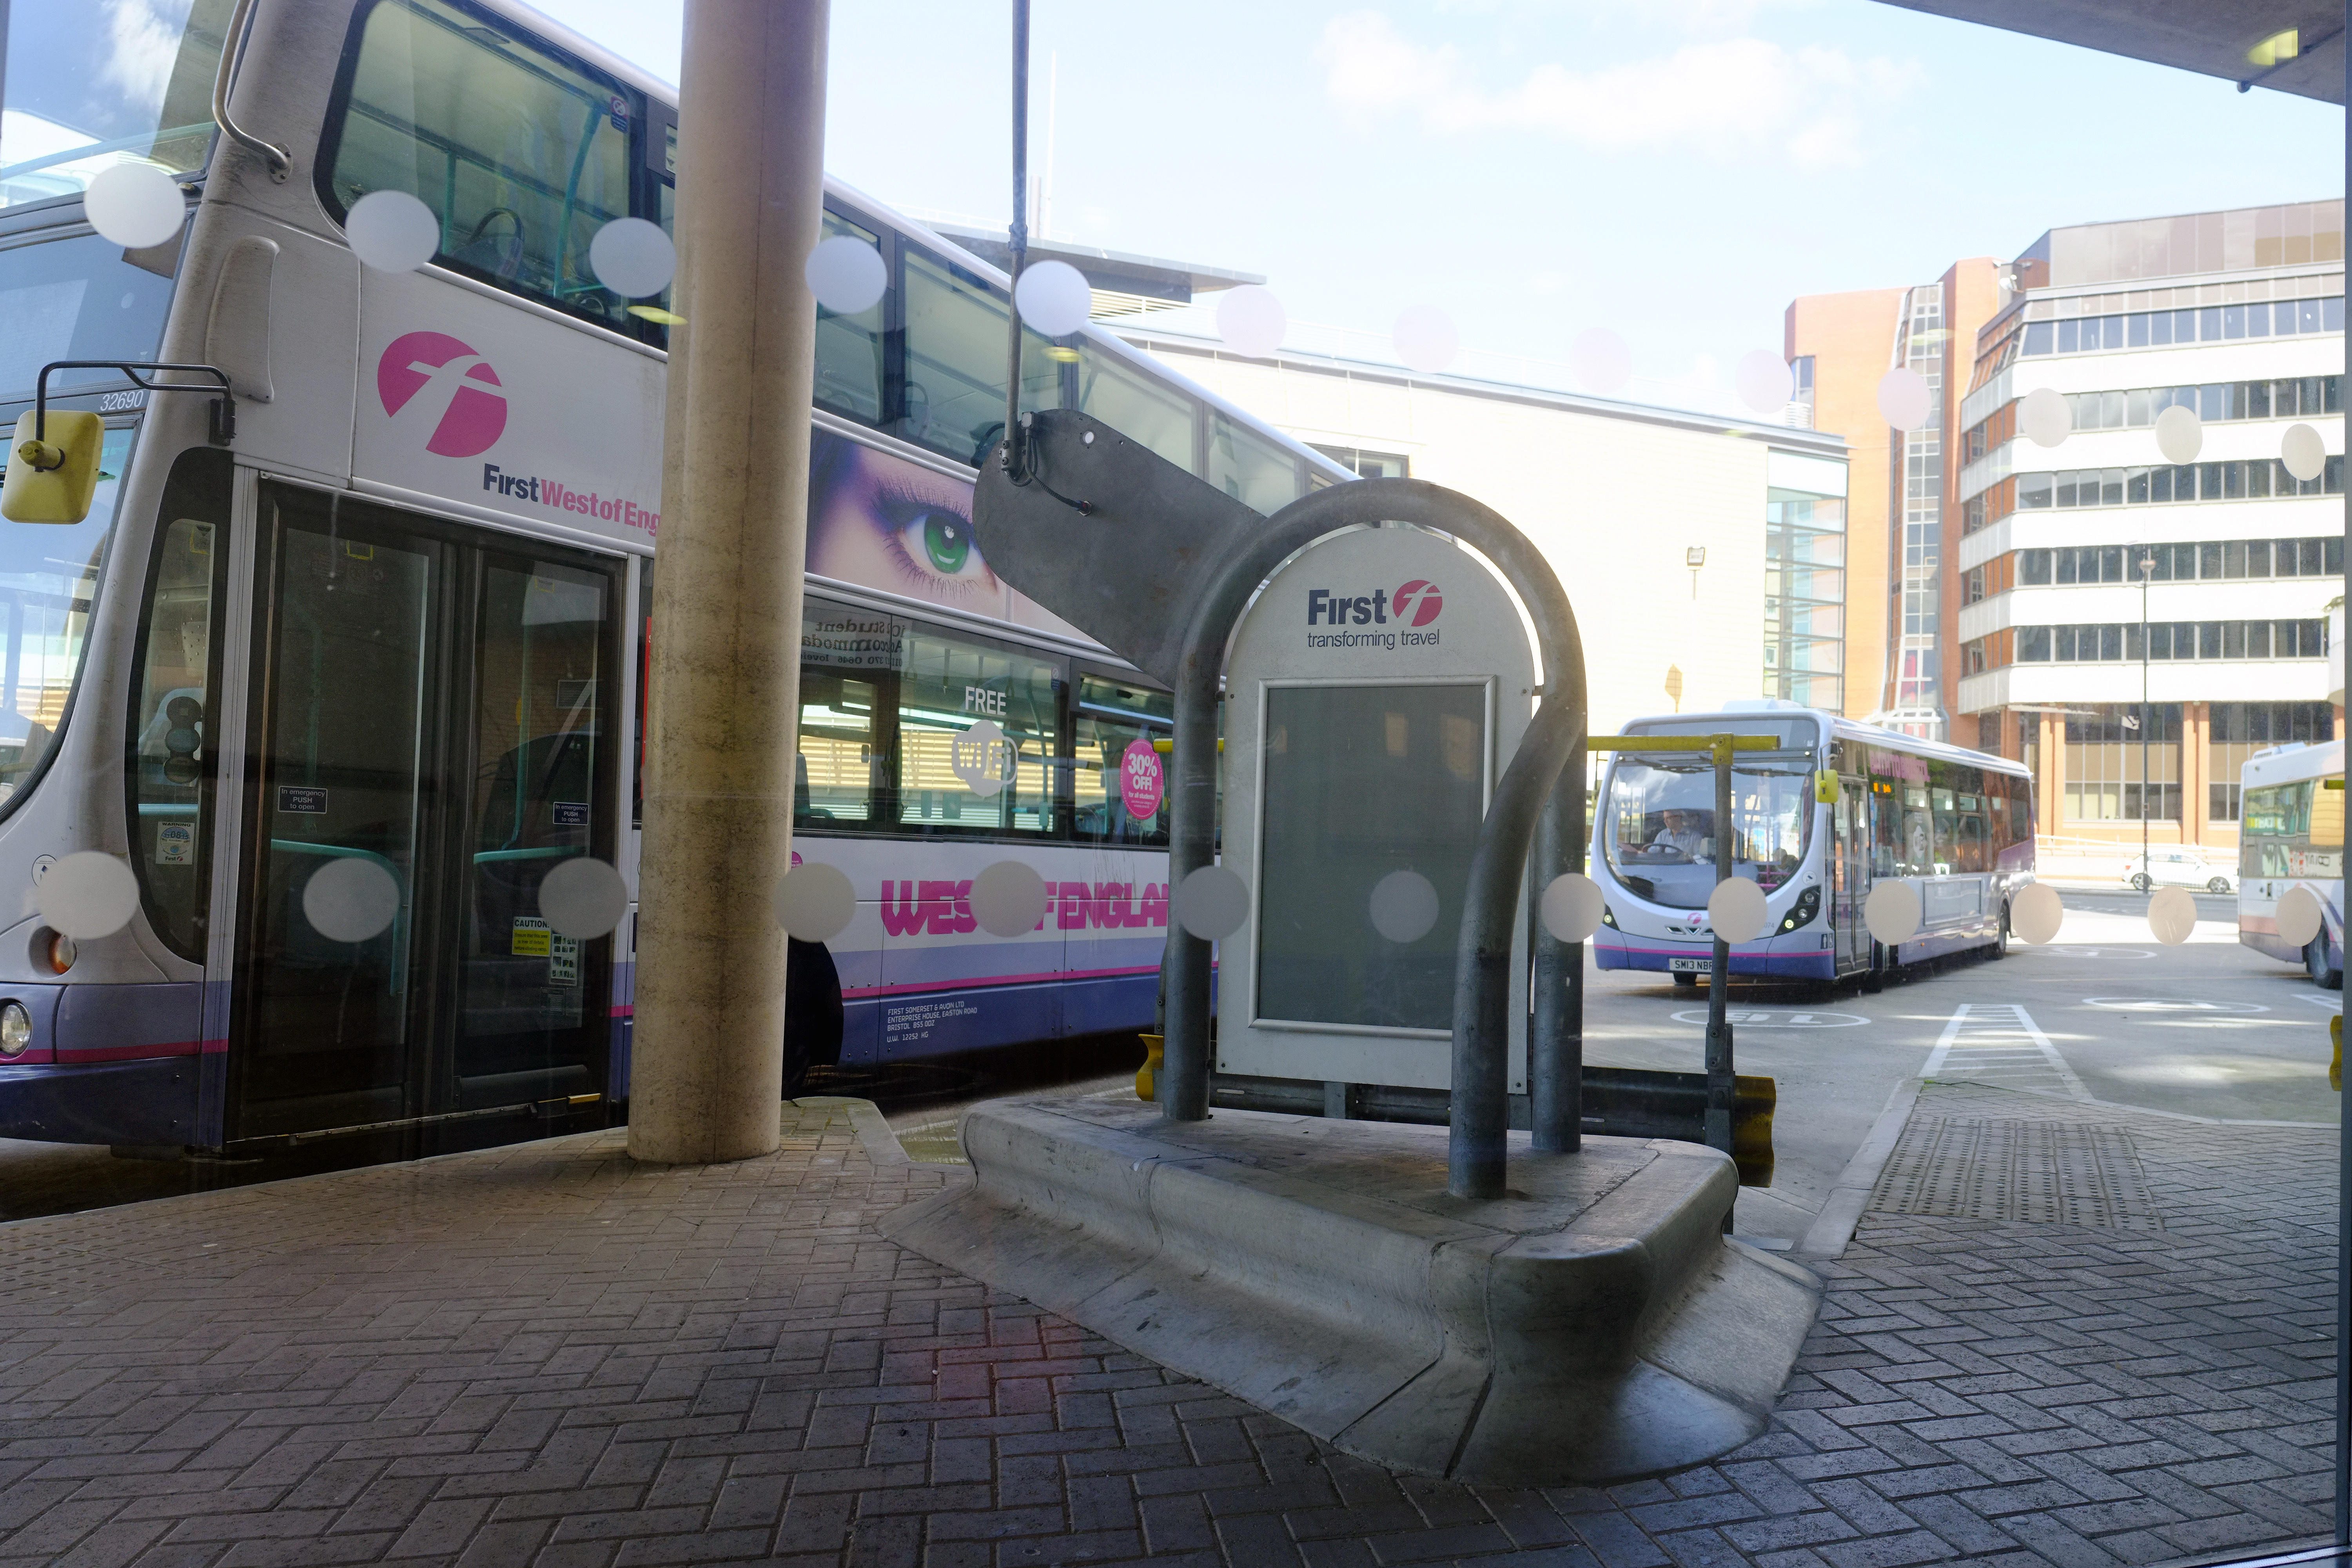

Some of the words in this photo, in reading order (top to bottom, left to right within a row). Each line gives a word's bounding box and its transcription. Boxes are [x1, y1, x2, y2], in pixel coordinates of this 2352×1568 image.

[100, 390, 143, 411] 32690
[483, 463, 539, 502] First
[1308, 589, 1387, 625] First
[1308, 630, 1395, 650] transforming
[1401, 629, 1439, 646] travel
[965, 686, 1006, 716] FREE
[1128, 753, 1157, 777] 30%
[1132, 775, 1152, 791] OFF!
[1675, 960, 1694, 969] SM13
[887, 1015, 921, 1024] ENTERPRISE
[942, 1009, 963, 1017] EASTON
[906, 1005, 933, 1014] SOMERSET
[887, 1023, 910, 1031] BRISTOL
